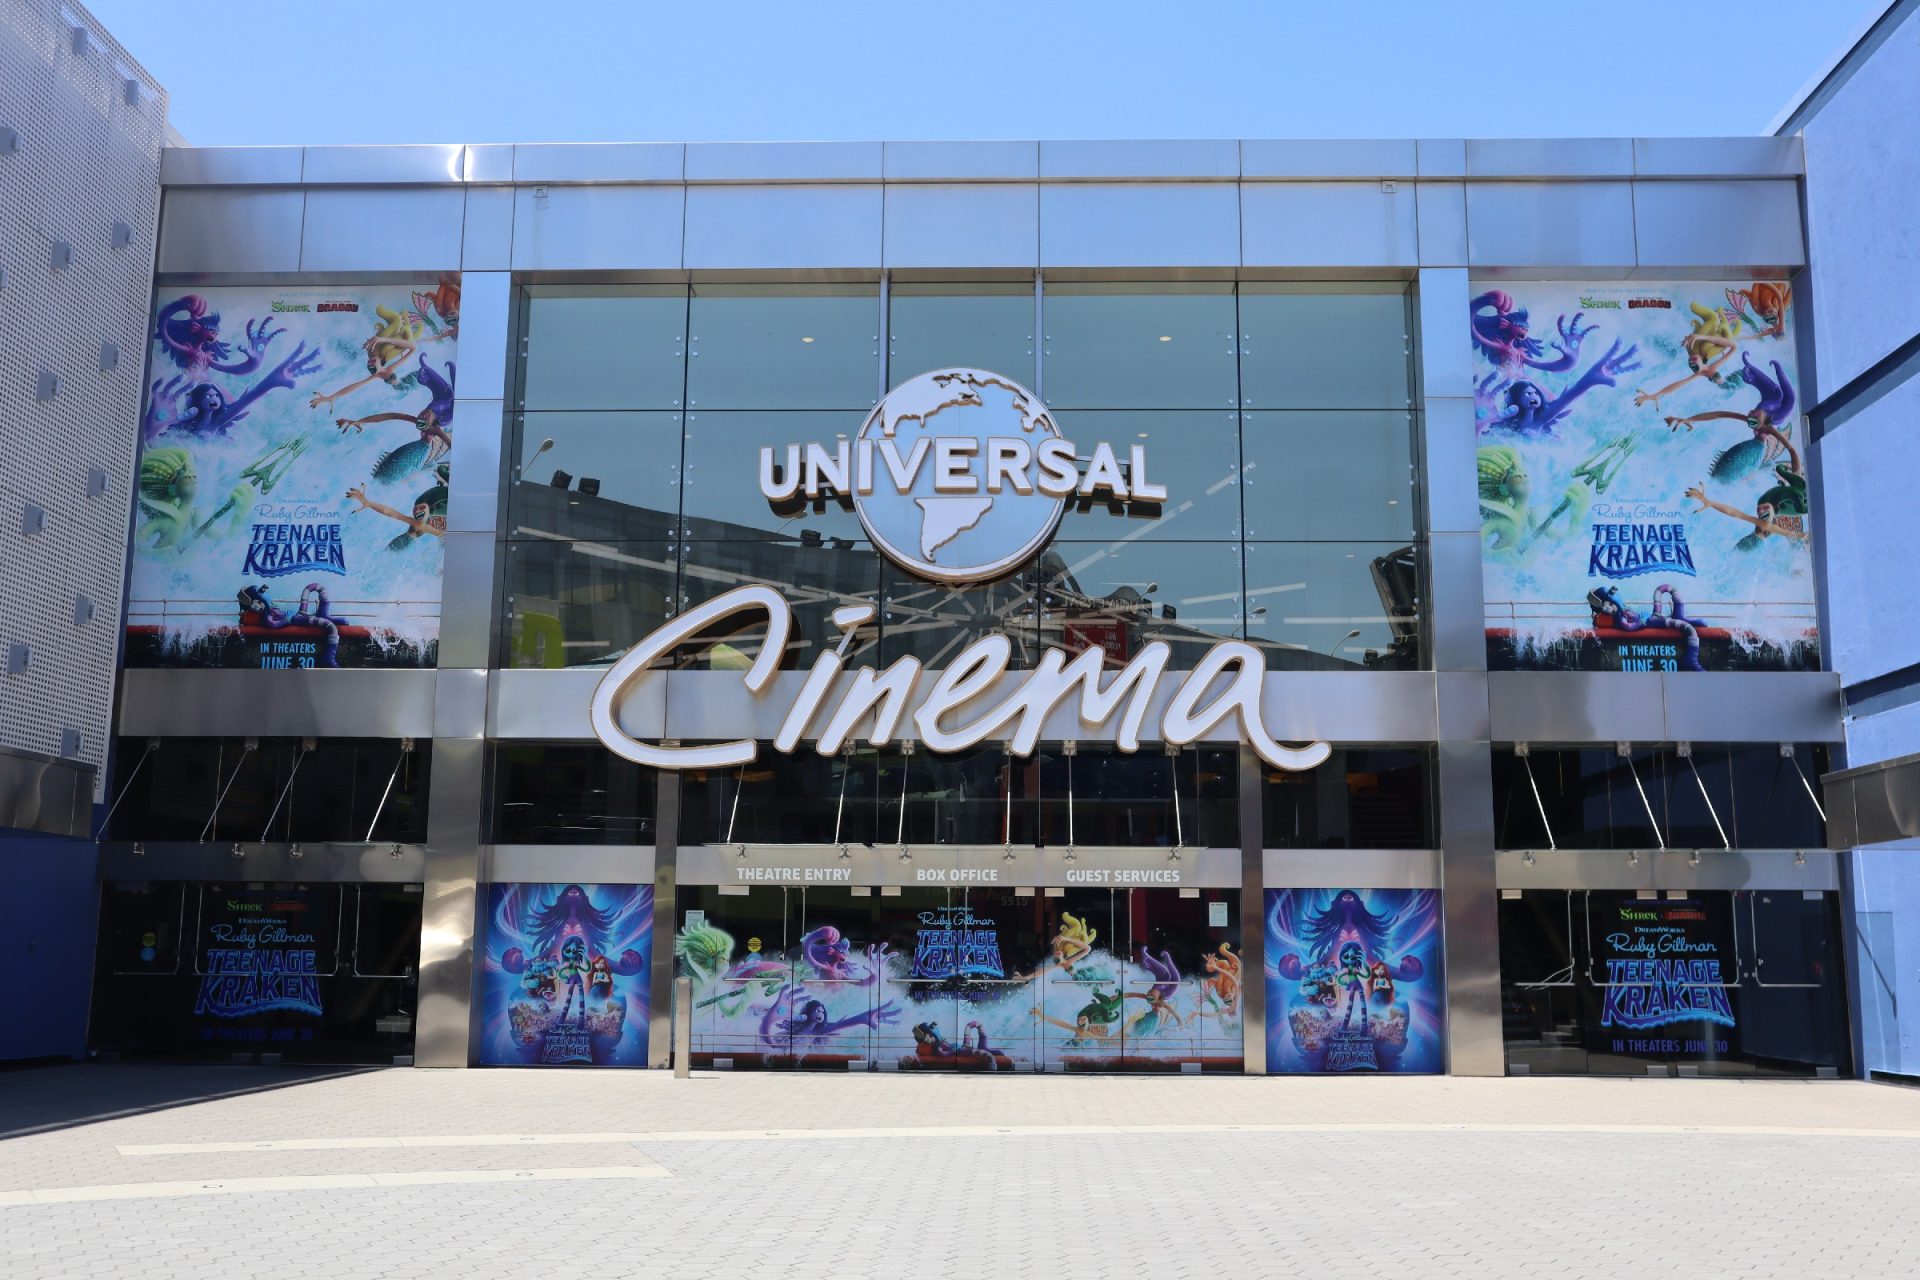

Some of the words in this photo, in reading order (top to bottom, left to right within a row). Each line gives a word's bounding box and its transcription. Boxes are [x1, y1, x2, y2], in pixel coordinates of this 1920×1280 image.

[759, 436, 1167, 502] UNIVERSAL
[254, 503, 292, 522] Ruby
[294, 504, 340, 519] Gillman
[1592, 503, 1632, 522] Ruby
[1634, 504, 1681, 519] Gillman
[252, 524, 342, 545] TEENAGE
[1592, 524, 1687, 545] TEENAGE
[242, 544, 346, 578] KRAKEN
[1588, 544, 1697, 579] KRAKEN
[260, 643, 269, 653] IN
[273, 643, 316, 653] THEATERS
[1618, 645, 1628, 656] IN
[1632, 645, 1676, 656] THEATERS
[592, 583, 1333, 770] Cinema
[736, 867, 800, 880] THEATRE
[805, 868, 852, 881] ENTRY
[917, 869, 945, 881] BOX
[949, 869, 998, 881] OFFICE
[1066, 869, 1111, 882] GUEST
[1114, 869, 1180, 883] SERVICES
[917, 912, 952, 929] Ruby
[210, 923, 257, 949] Ruby
[258, 925, 315, 943] Gillman
[917, 930, 998, 947] TEENAGE
[1606, 933, 1656, 958] Ruby
[1657, 934, 1717, 953] Gillman
[207, 949, 316, 974] TEENAGE
[911, 948, 1004, 979] KRAKEN
[1606, 959, 1723, 985] TEENAGE
[194, 974, 322, 1017] KRAKEN
[1601, 984, 1736, 1030] KRAKEN
[1612, 1040, 1624, 1053] IN
[1628, 1040, 1681, 1053] THEATERS
[1715, 1040, 1728, 1053] 30
